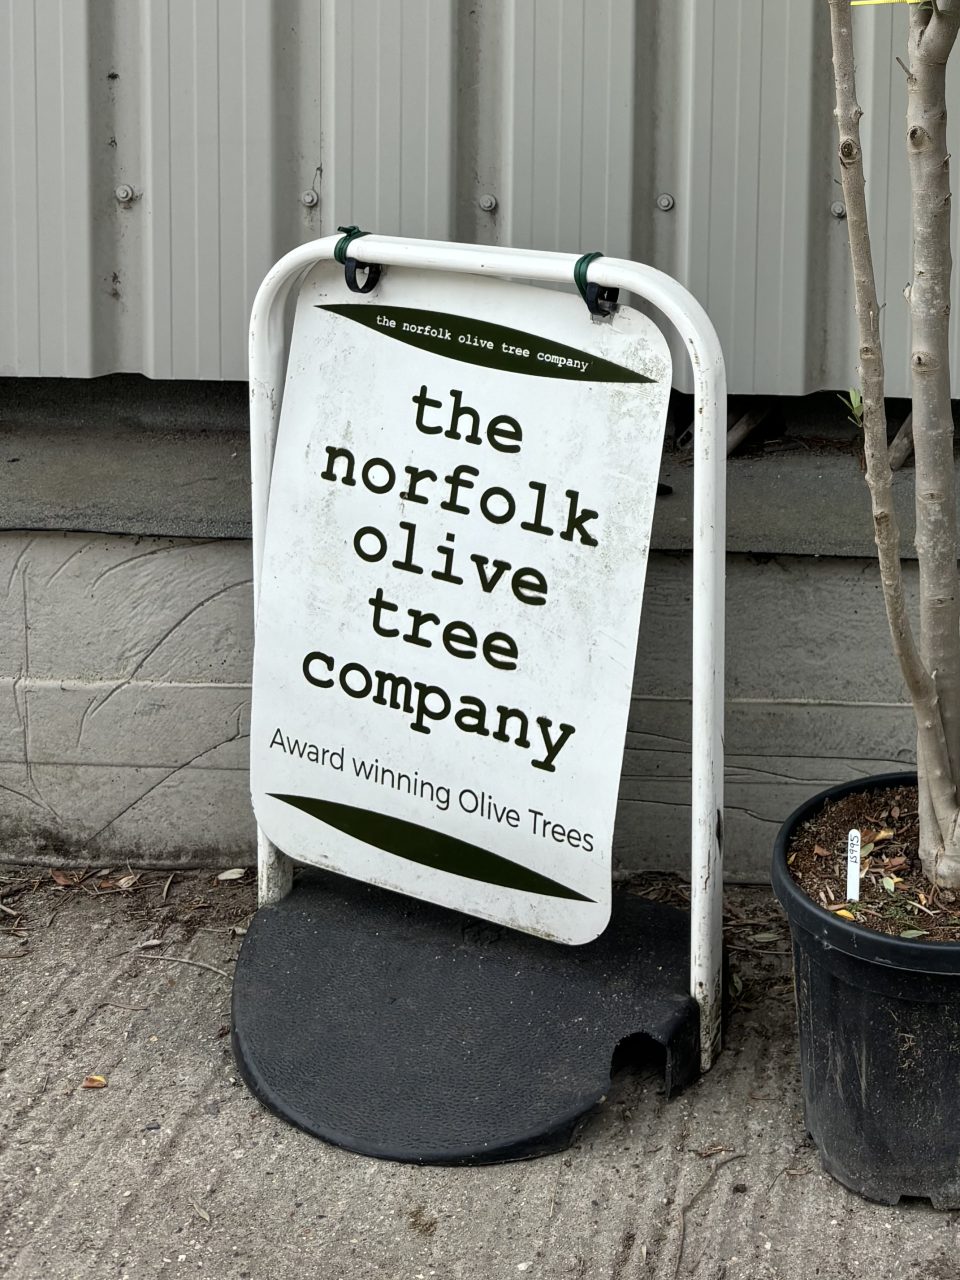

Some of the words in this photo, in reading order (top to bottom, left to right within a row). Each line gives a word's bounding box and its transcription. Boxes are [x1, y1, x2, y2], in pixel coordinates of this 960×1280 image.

[377, 315, 397, 328] the
[402, 322, 452, 341] norfolk
[458, 333, 494, 350] olive
[501, 341, 531, 358] tree
[537, 351, 589, 373] company
[411, 384, 523, 455] the
[320, 445, 600, 549] norfolk
[353, 521, 549, 607] olive
[368, 587, 520, 672] tree
[302, 650, 577, 774] company
[269, 727, 345, 773] Award
[352, 756, 451, 811] winning
[457, 787, 521, 829] Olive
[527, 807, 595, 854] Trees
